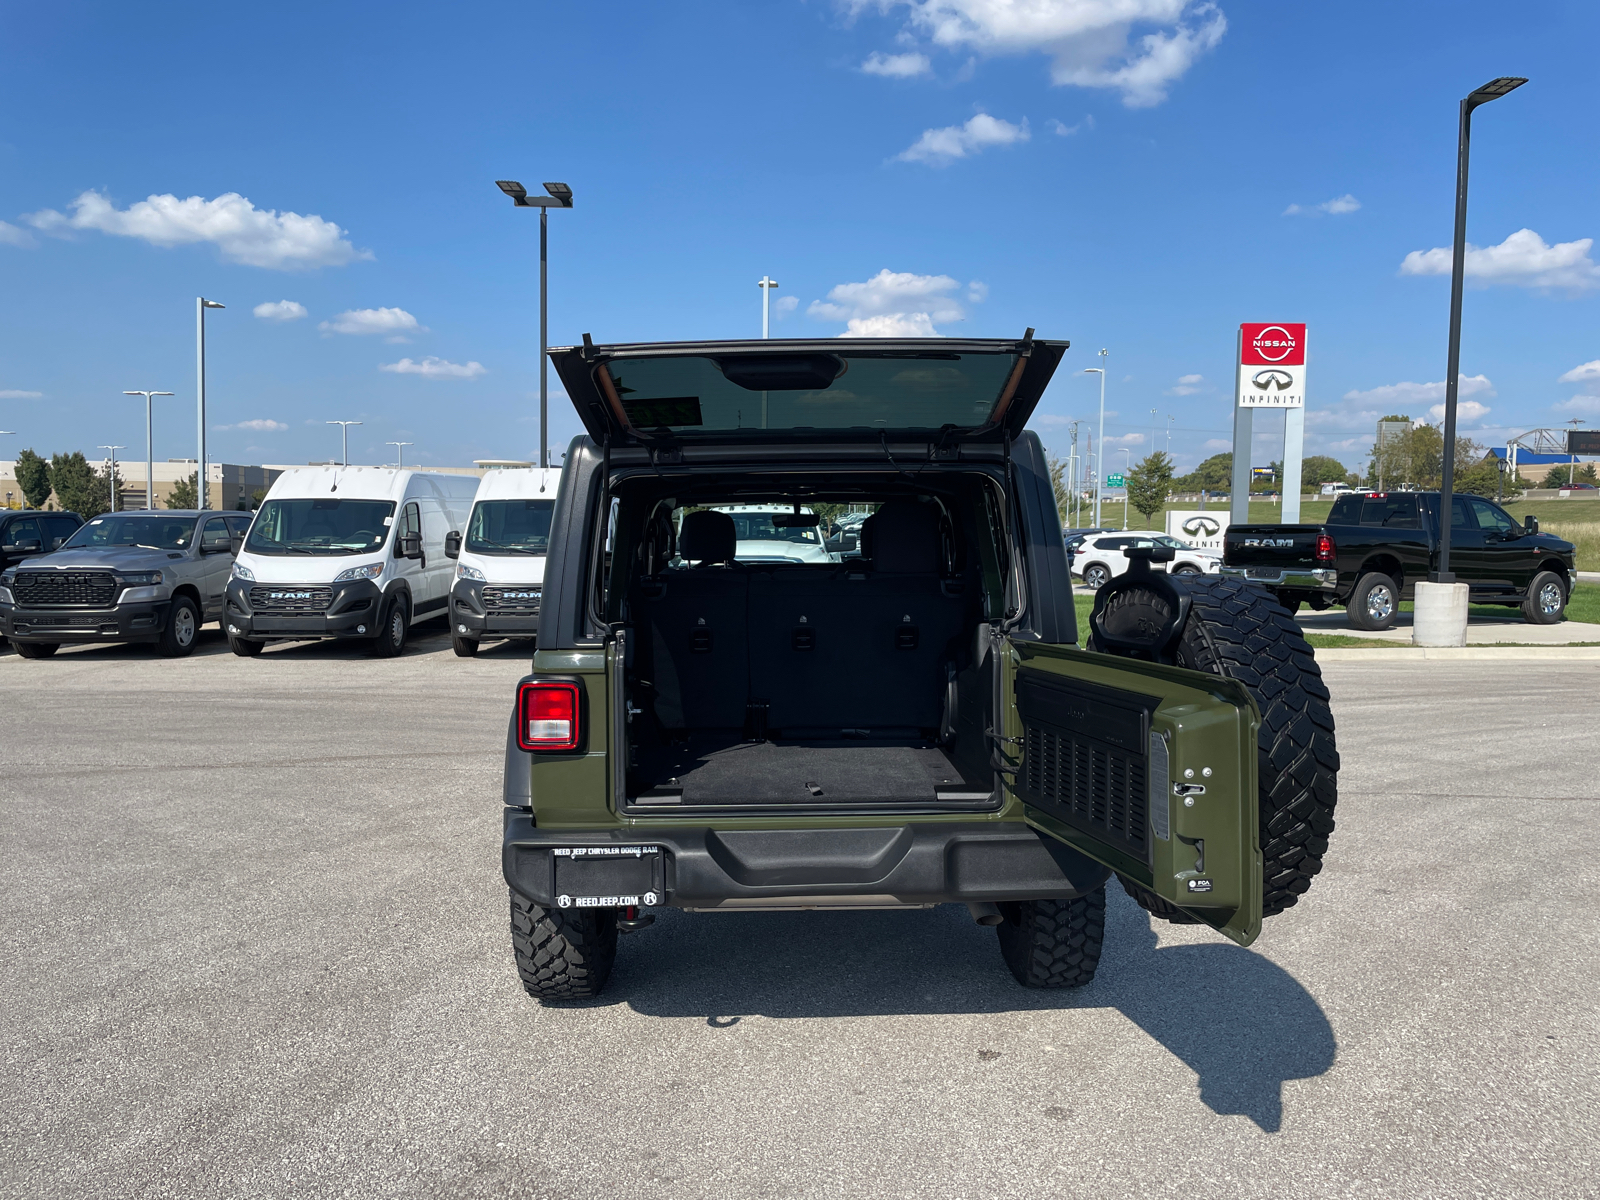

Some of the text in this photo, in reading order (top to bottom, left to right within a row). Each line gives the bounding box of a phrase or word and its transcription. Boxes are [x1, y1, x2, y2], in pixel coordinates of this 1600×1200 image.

[1243, 395, 1301, 403] INFINITI
[1244, 539, 1294, 547] RAM
[37, 576, 85, 584] RAM
[554, 848, 570, 856] REED
[571, 847, 586, 855] JEEP
[588, 847, 619, 855] CHRYSLER
[620, 846, 642, 854] DODGE
[576, 896, 639, 907] REEDJEEP.COM
